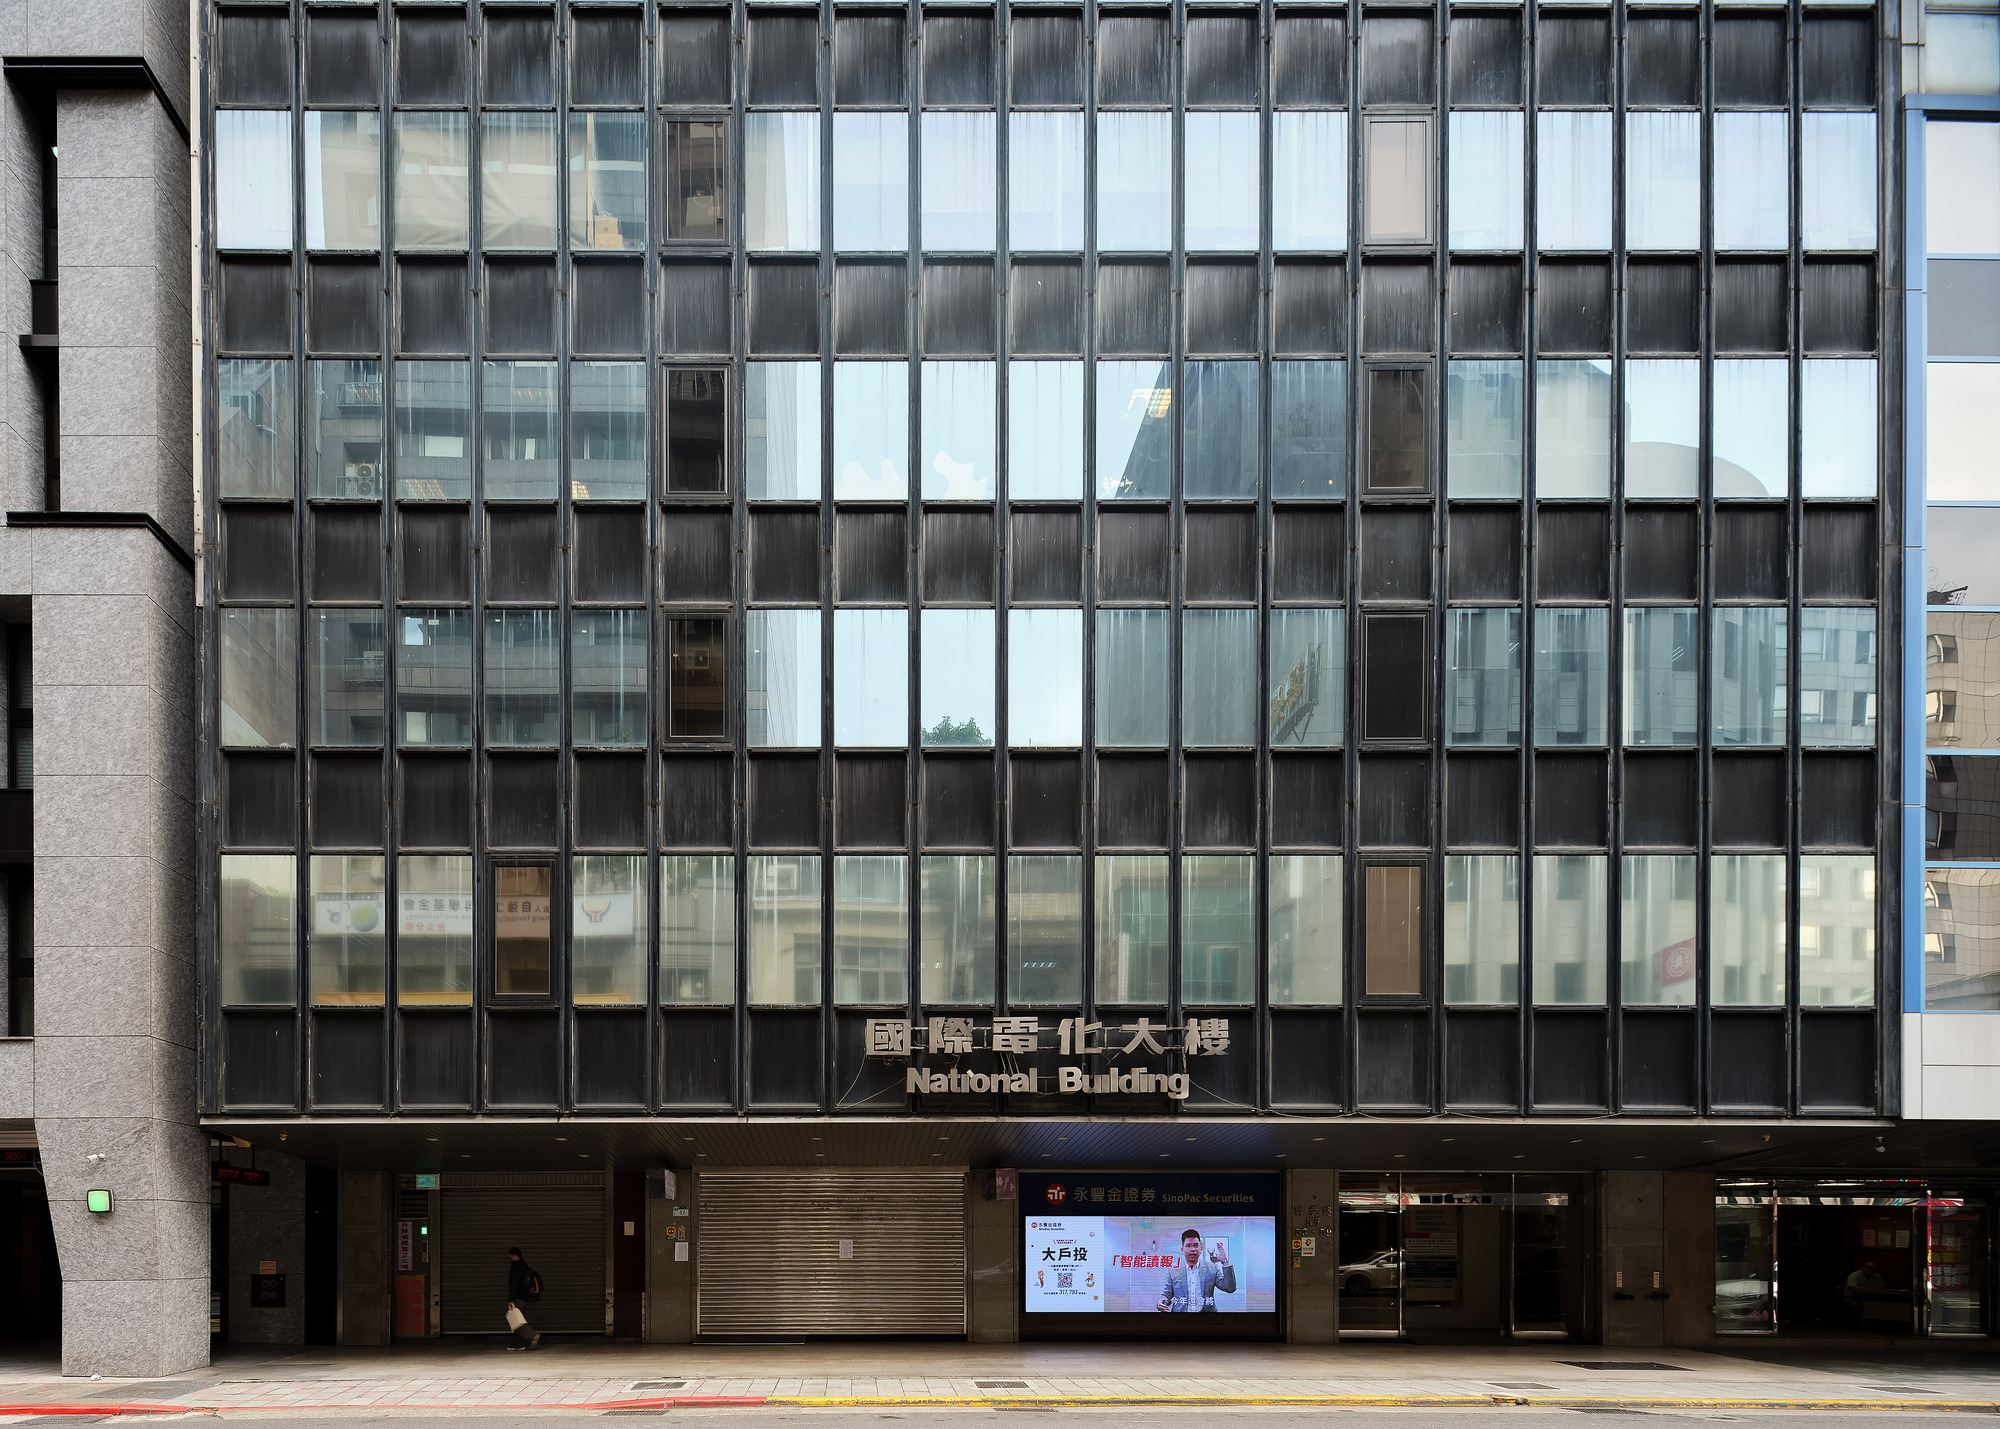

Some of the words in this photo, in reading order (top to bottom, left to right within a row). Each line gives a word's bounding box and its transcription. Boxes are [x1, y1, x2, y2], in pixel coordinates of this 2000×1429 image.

[866, 1016, 1231, 1056] 國際電化大樓
[906, 1067, 1038, 1094] National
[1059, 1066, 1190, 1099] Building
[1073, 1187, 1156, 1203] 永豐金證券
[1162, 1193, 1203, 1204] SinoPac
[1203, 1193, 1254, 1204] Securities
[1042, 1247, 1088, 1262] 大戶投
